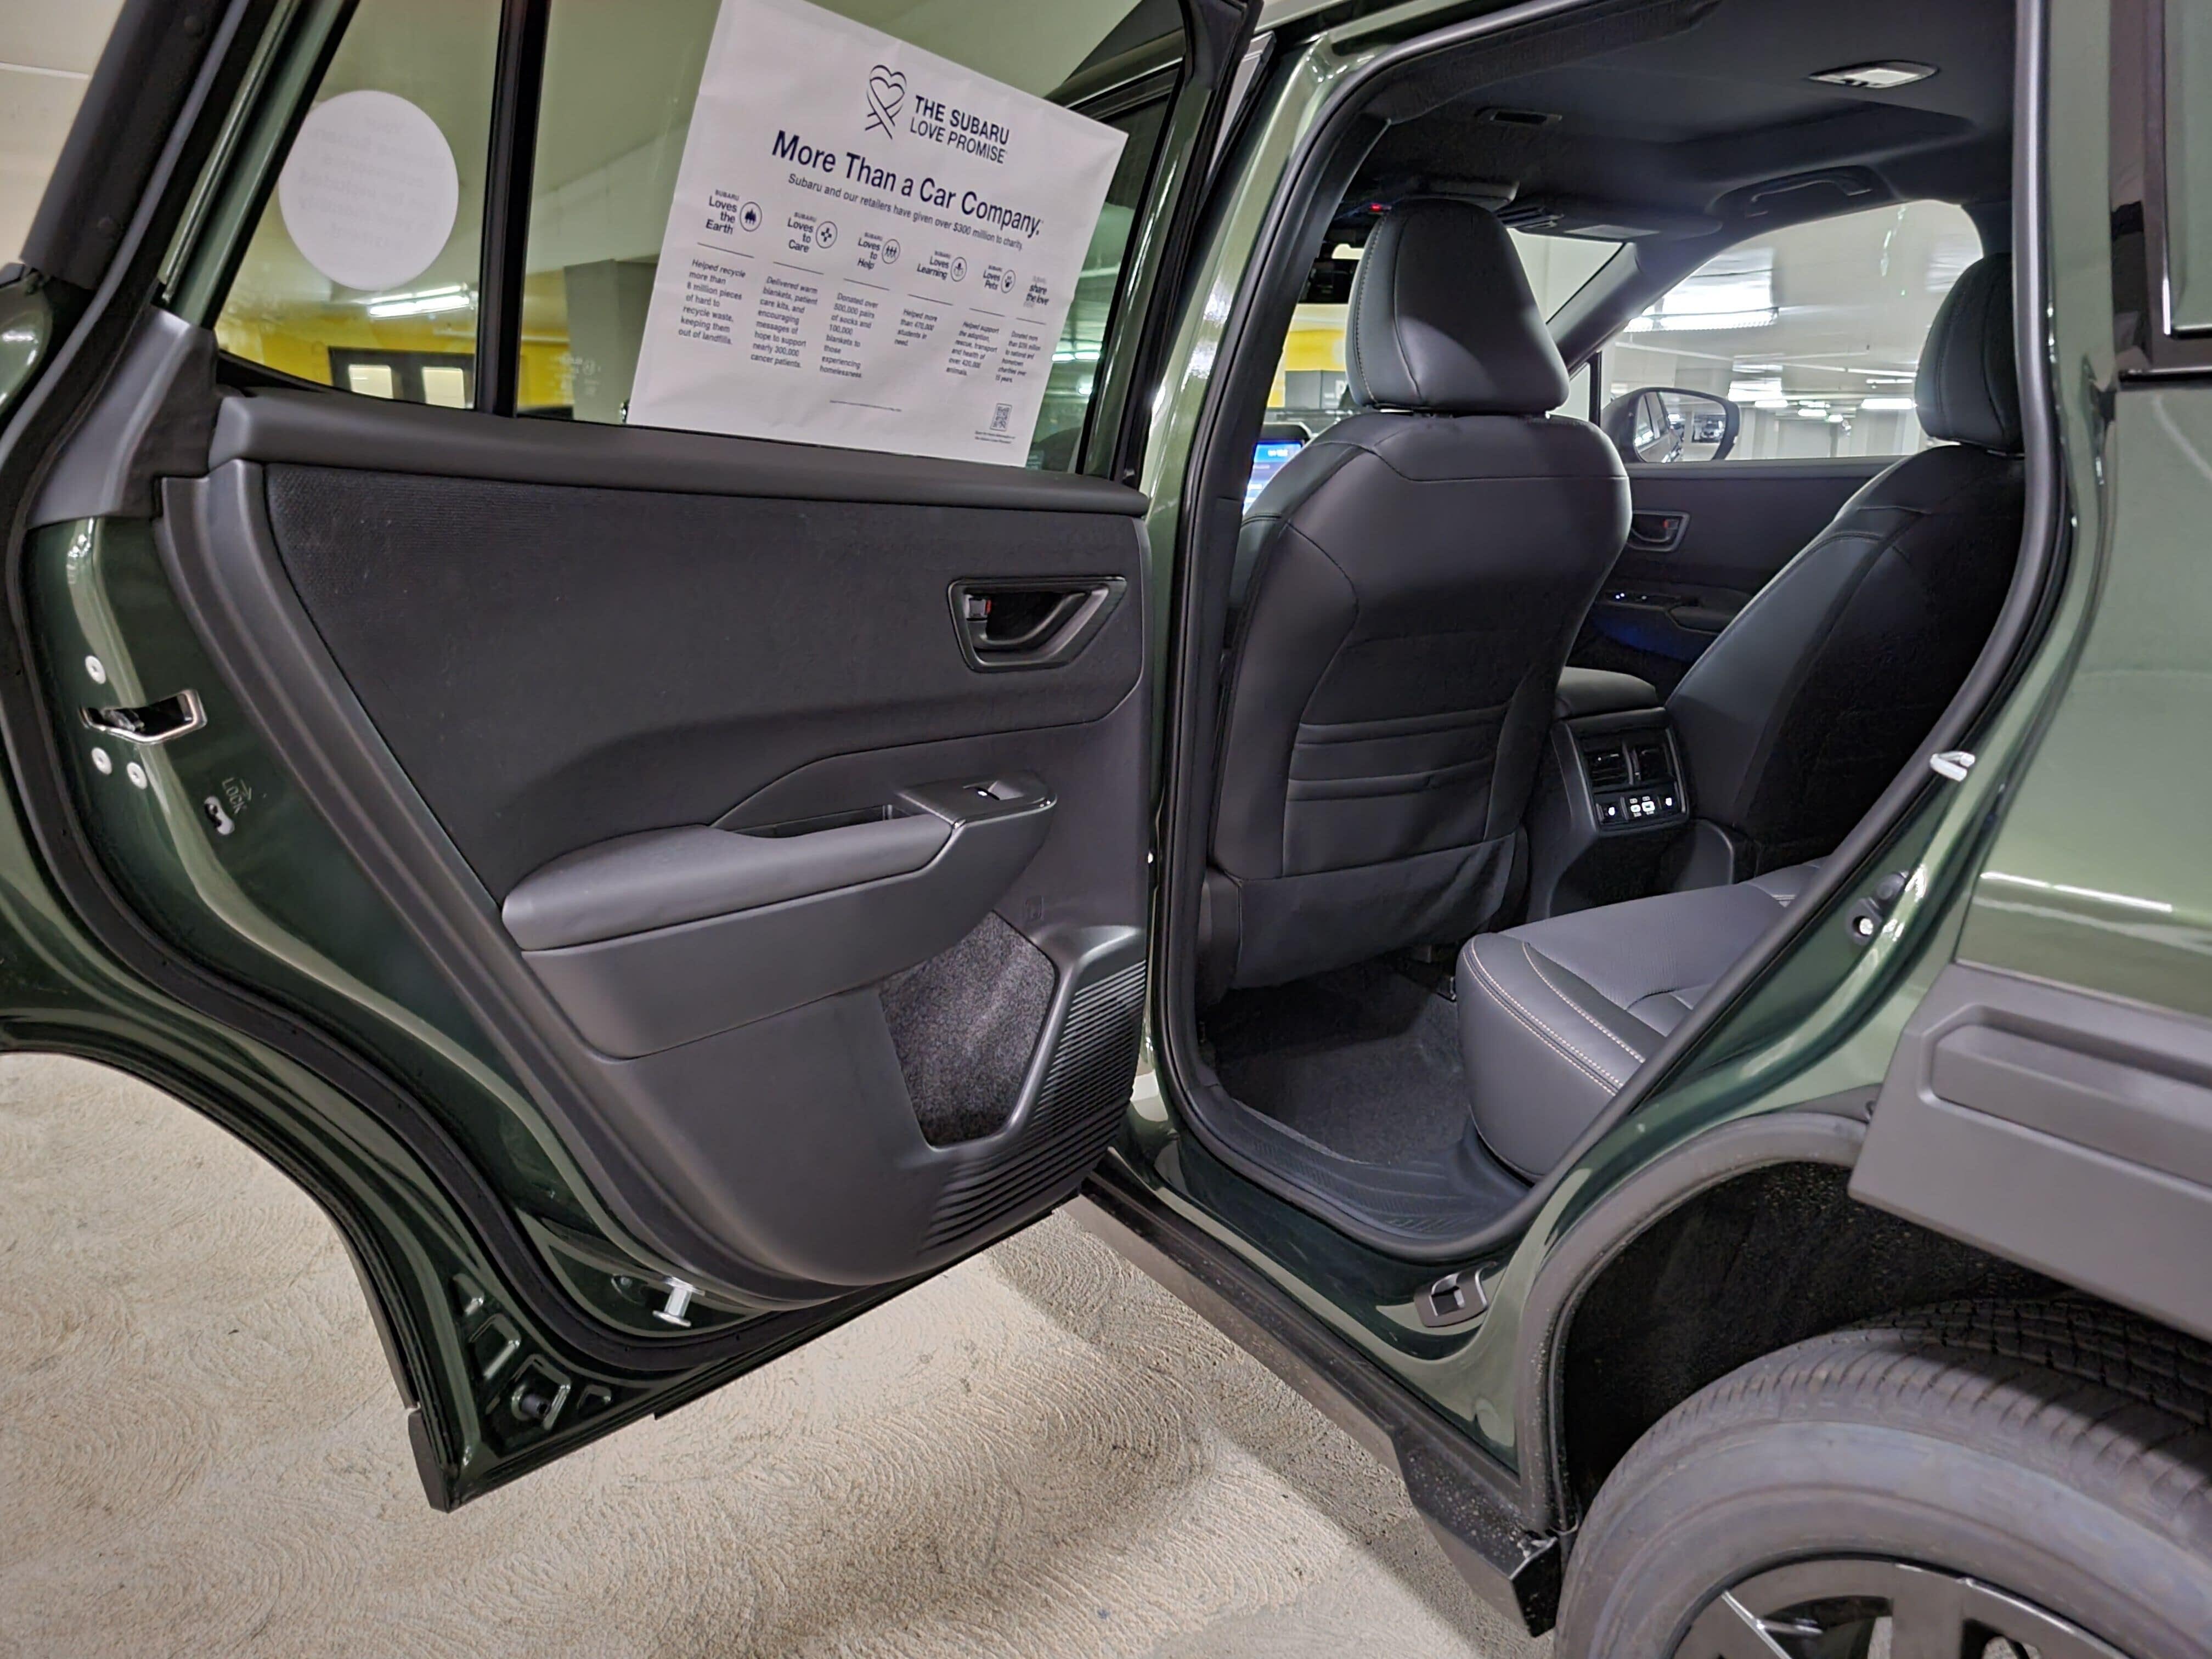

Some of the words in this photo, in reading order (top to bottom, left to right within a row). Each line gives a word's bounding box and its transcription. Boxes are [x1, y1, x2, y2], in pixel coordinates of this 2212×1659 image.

[915, 95, 946, 122] THE
[949, 109, 1009, 145] SUBARU
[910, 117, 946, 143] LOVE
[947, 131, 1006, 164] PROMISE
[771, 129, 836, 173] More
[846, 151, 896, 192] Than
[901, 178, 913, 197] a
[919, 177, 956, 208] Car
[715, 189, 740, 201] SUBARU
[709, 195, 737, 212] Loves
[788, 173, 822, 192] Subaru
[824, 185, 842, 198] and
[843, 191, 859, 202] our
[860, 196, 891, 212] retailers
[893, 205, 911, 218] have
[913, 212, 933, 223] given
[935, 218, 952, 229] over
[953, 222, 972, 235] $300
[972, 229, 995, 242] million
[996, 234, 1002, 244] to
[720, 211, 735, 223] the
[706, 218, 733, 235] Earth
[787, 217, 814, 233] Loves
[803, 233, 811, 243] to
[858, 238, 881, 251] Loves
[789, 239, 809, 253] Care
[870, 251, 878, 259] to
[692, 259, 719, 272] Helped
[720, 267, 746, 278] recycle
[857, 258, 875, 270] Help
[929, 256, 949, 269] Loves
[917, 263, 947, 280] Learning
[983, 269, 1000, 281] Loves
[689, 272, 708, 280] more
[710, 275, 726, 285] than
[766, 276, 799, 290] Delivered
[800, 285, 818, 294] warm
[693, 284, 718, 295] million
[719, 290, 742, 300] pieces
[837, 292, 864, 305] Donated
[695, 296, 712, 306] hard
[713, 299, 720, 307] to
[760, 299, 775, 307] care
[794, 295, 818, 305] patient
[683, 306, 710, 317] recycle
[758, 310, 799, 325] encouraging
[681, 315, 711, 330] keeping
[713, 323, 730, 332] them
[756, 321, 789, 333] messages
[754, 331, 771, 341] hope
[781, 337, 806, 347] support
[826, 334, 853, 346] blankets
[753, 343, 773, 353] nearly
[824, 345, 842, 354] those
[751, 354, 774, 363] cancer
[822, 356, 861, 370] experiencing
